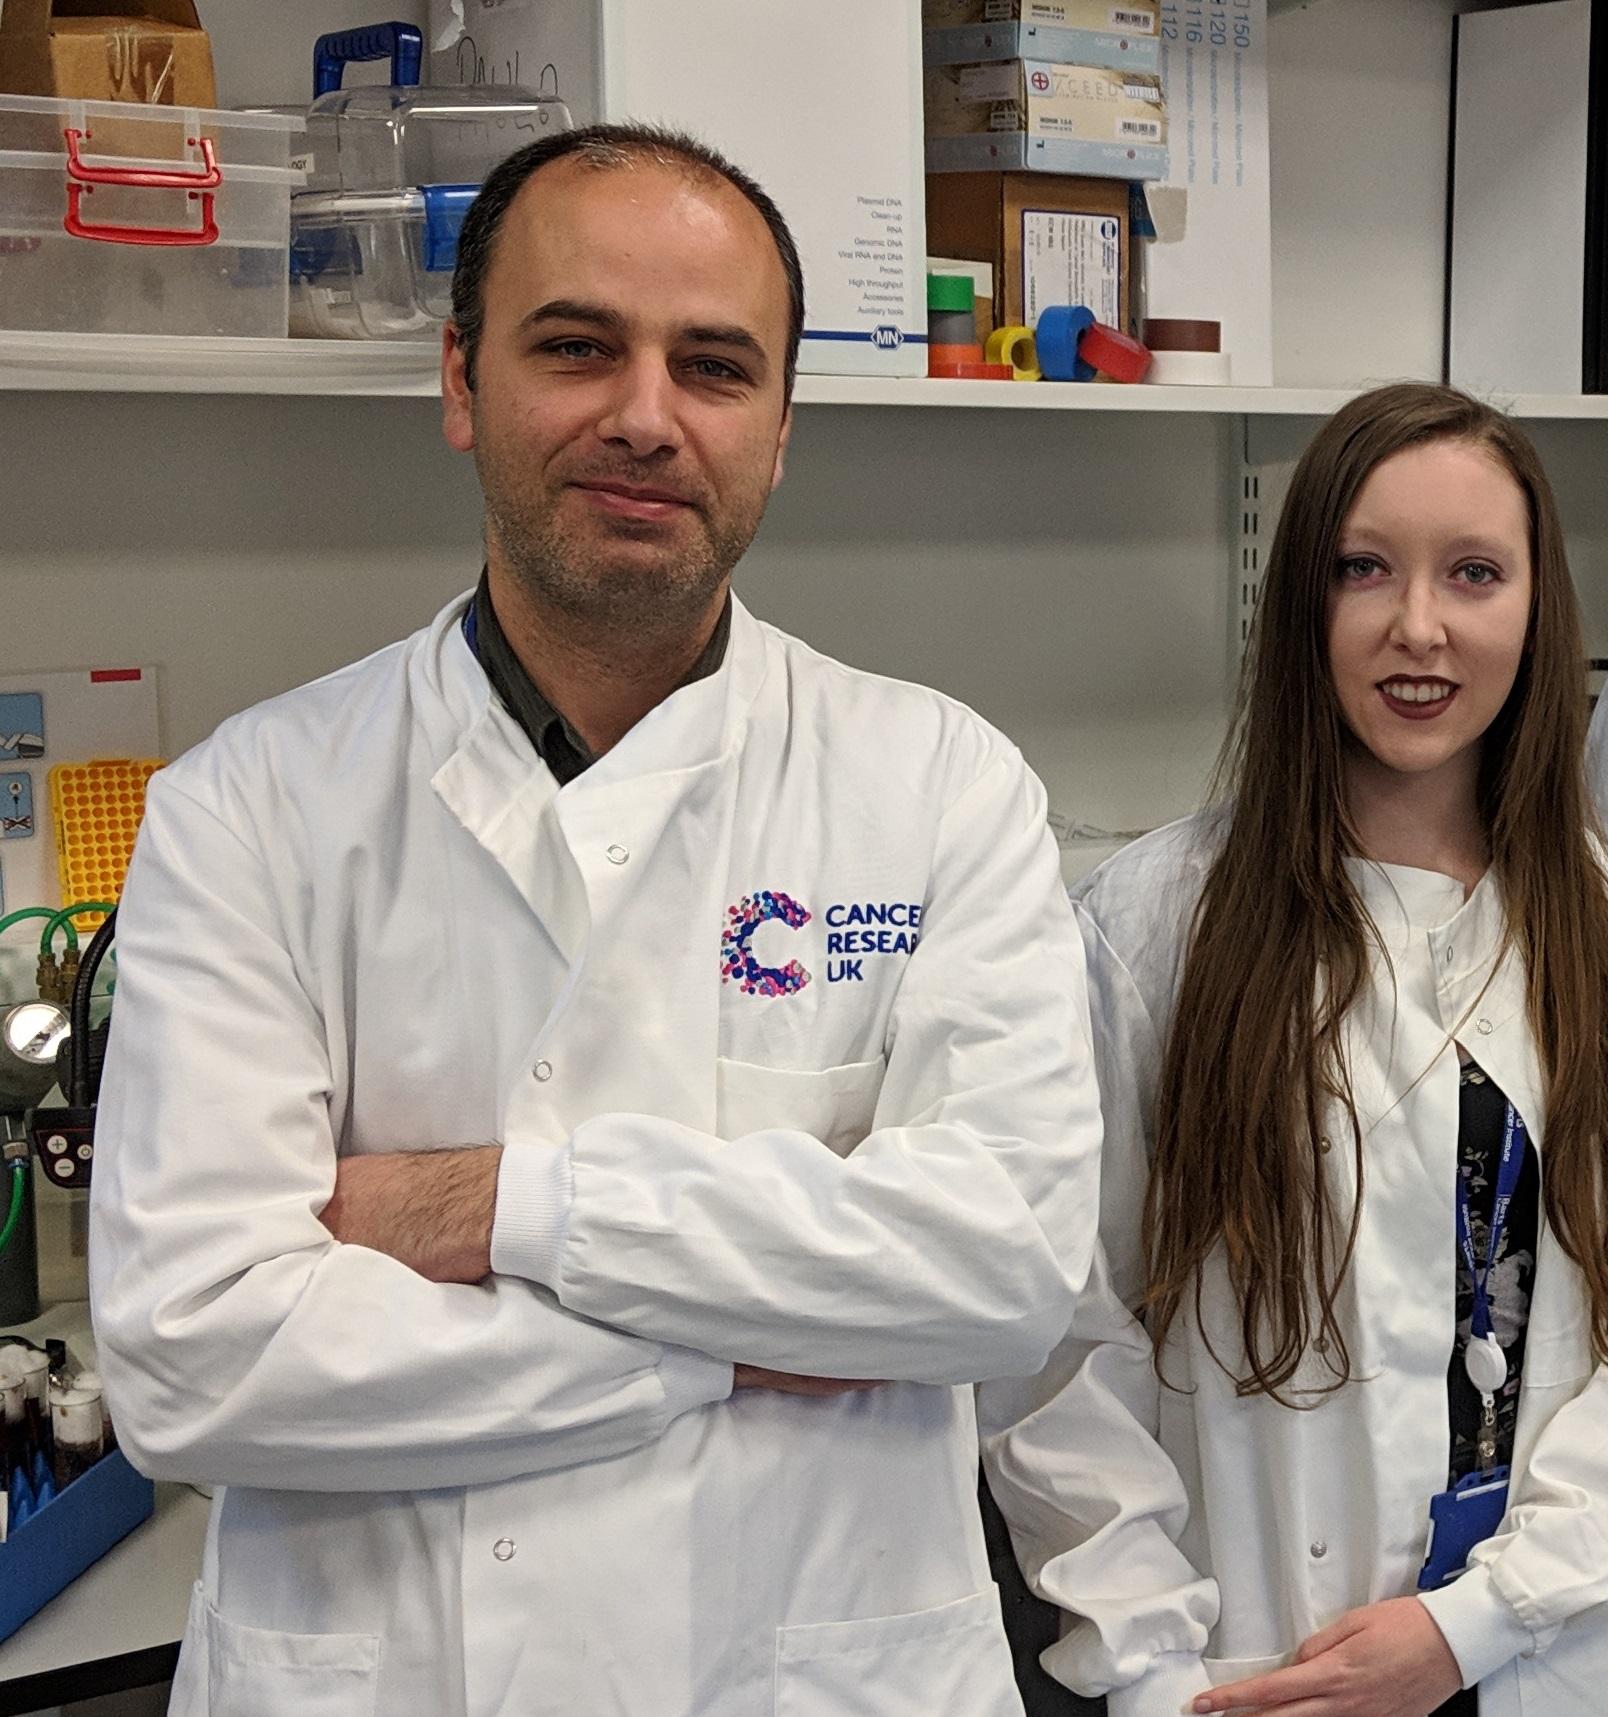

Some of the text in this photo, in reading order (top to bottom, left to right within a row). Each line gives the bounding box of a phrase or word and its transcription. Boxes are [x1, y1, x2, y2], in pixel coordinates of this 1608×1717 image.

[1161, 4, 1178, 40] 112
[1185, 7, 1202, 43] 116
[1209, 10, 1226, 45] 120
[1233, 13, 1250, 48] 150
[886, 198, 903, 207] DNA
[886, 226, 903, 234] RNA
[886, 238, 904, 248] DNA
[854, 251, 872, 260] RNA
[887, 252, 903, 261] DNA
[876, 330, 898, 345] MN
[825, 903, 923, 928] CANCE
[827, 930, 920, 955] RESEA
[827, 959, 863, 983] UK
